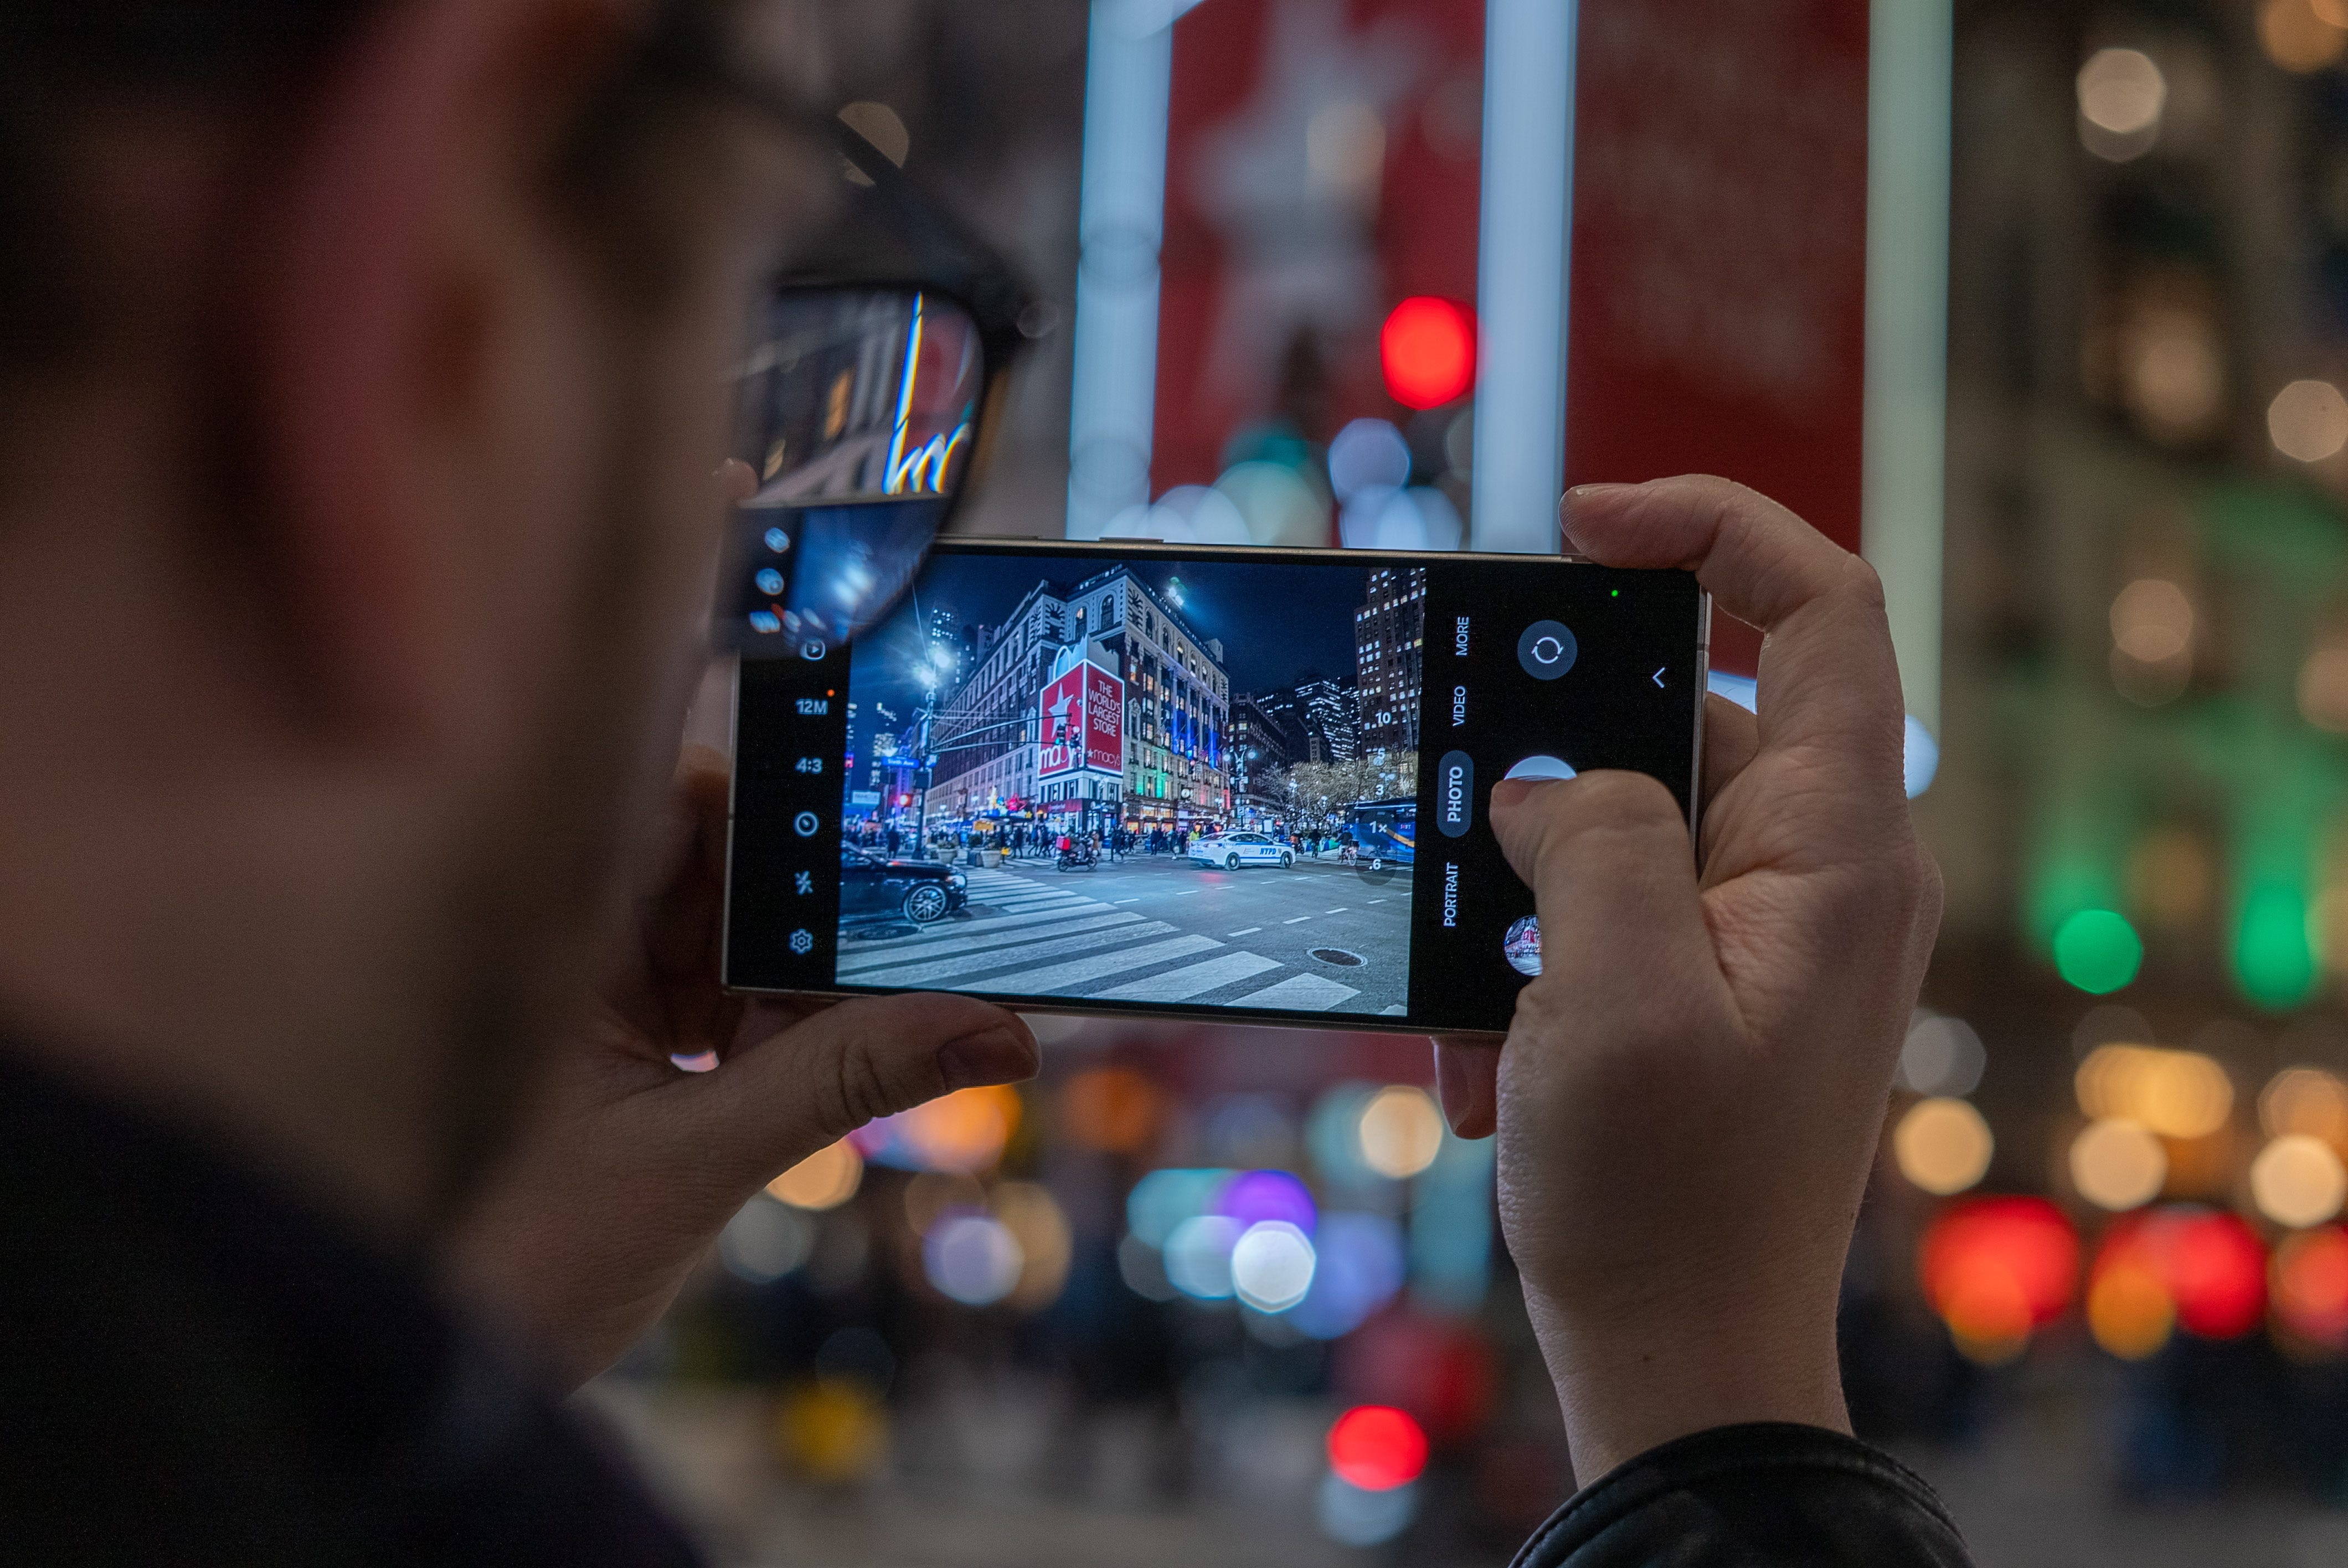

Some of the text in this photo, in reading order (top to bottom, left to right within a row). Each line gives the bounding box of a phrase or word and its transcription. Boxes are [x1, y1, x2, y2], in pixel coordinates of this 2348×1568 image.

[1456, 616, 1469, 656] MORE
[1098, 679, 1113, 698] THE
[796, 699, 827, 714] 12M
[1088, 688, 1121, 714] WORLD'S
[1453, 685, 1466, 726] VIDEO
[1088, 702, 1120, 726] LARGEST
[1375, 712, 1392, 724] 10
[1093, 718, 1116, 737] STORE
[1377, 748, 1385, 759] 5
[795, 757, 823, 773] 4:3
[1375, 784, 1384, 796] 3
[1447, 765, 1463, 823] PHOTO
[1369, 821, 1387, 833] 1x
[1443, 862, 1459, 927] PORTRAIT
